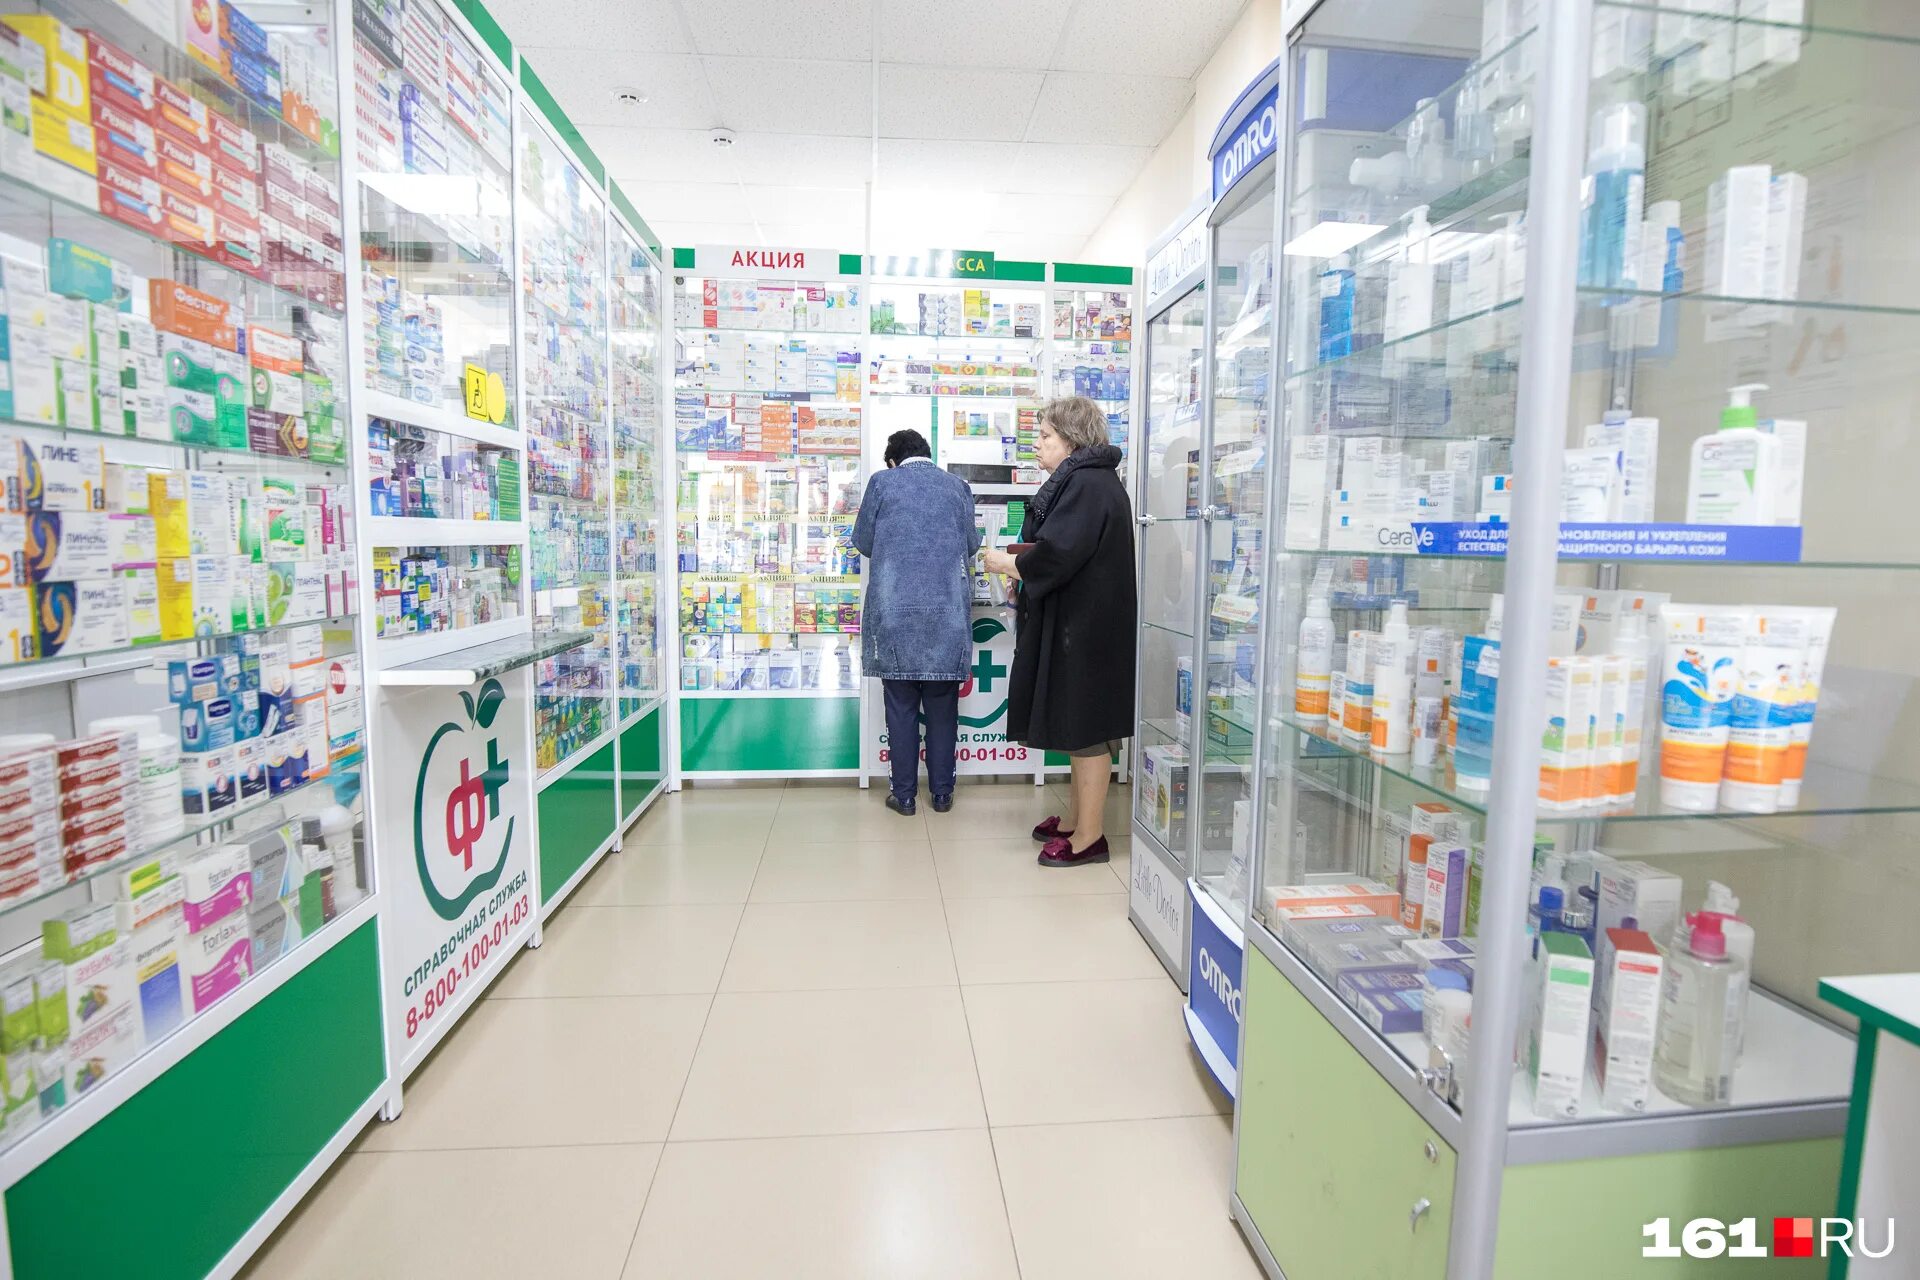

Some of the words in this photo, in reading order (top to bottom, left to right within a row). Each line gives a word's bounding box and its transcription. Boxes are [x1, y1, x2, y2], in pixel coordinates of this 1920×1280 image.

[1222, 105, 1279, 188] OMRO
[731, 250, 805, 269] АКЦИЯ
[41, 445, 79, 462] ЛИНЕ
[1378, 526, 1434, 547] CeraVe
[1458, 529, 1488, 540] УХОД
[1558, 530, 1635, 541] АНОВЛЕНИЯ
[1638, 531, 1649, 541] И
[1651, 531, 1727, 543] УКРЕПЛЕНИЯ
[1458, 542, 1508, 552] ЕСТЕСТВЕН
[1557, 543, 1632, 555] АЩИТНОГО
[1635, 544, 1687, 555] БАРЬЕРА
[1689, 545, 1726, 556] КОЖИ
[972, 733, 1007, 743] СЛУЖ
[1153, 873, 1180, 937] Doctor
[202, 924, 238, 953] forlax
[403, 904, 487, 998] СПРАВОЧНАЯ
[488, 869, 528, 917] СЛУЖБА
[405, 893, 529, 1040] 8-800-100-01-03
[1199, 946, 1242, 1025] OMRO
